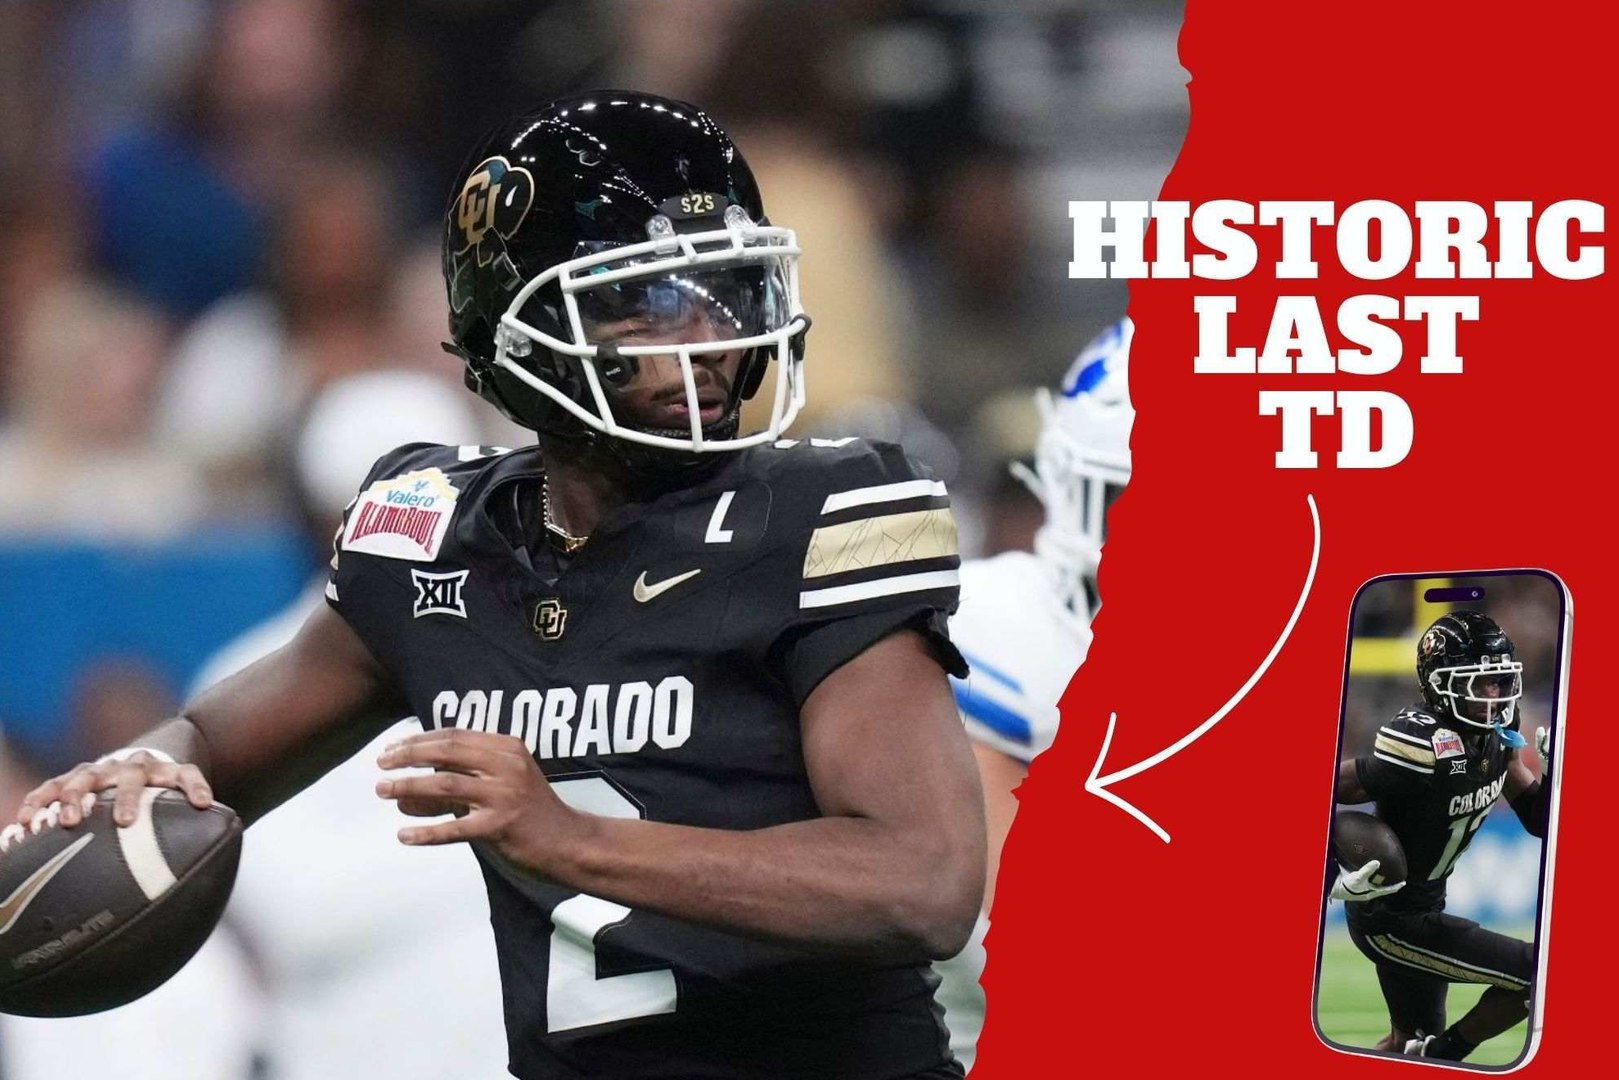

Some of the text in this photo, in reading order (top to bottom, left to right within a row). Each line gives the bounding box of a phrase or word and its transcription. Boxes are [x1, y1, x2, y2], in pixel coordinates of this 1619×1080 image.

[458, 169, 502, 244] CU
[681, 194, 715, 214] S2S
[386, 489, 435, 508] Valero
[704, 491, 736, 543] L
[414, 574, 465, 613] XII
[533, 600, 567, 640] CU
[432, 675, 694, 760] COLORADO
